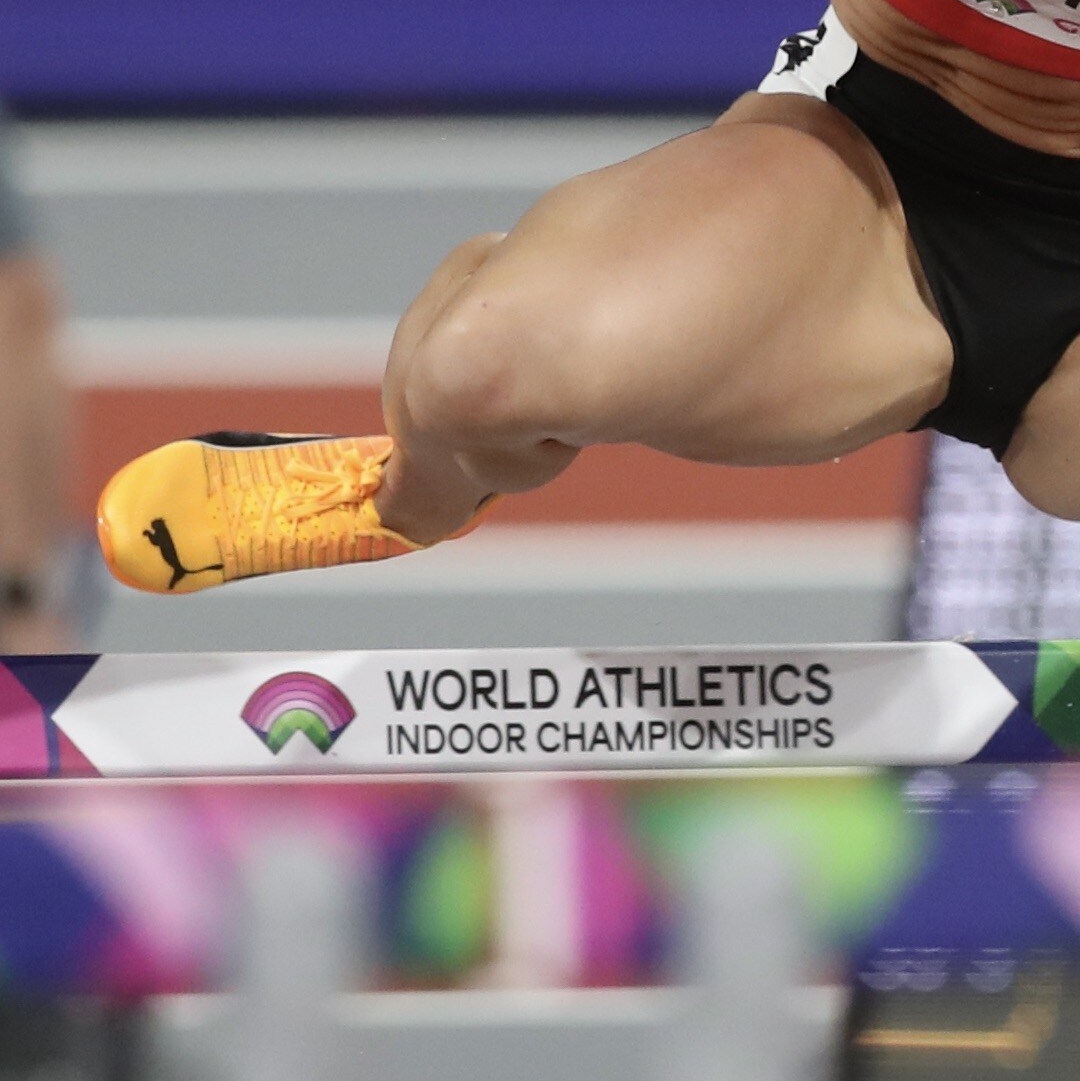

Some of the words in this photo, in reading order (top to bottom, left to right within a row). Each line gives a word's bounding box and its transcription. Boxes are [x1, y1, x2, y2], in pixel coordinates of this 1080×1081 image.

[386, 669, 559, 711] WORLD
[574, 663, 833, 708] ATHLETICS
[386, 722, 526, 755] INDOOR
[537, 717, 835, 752] CHAMPIONSHIPS
